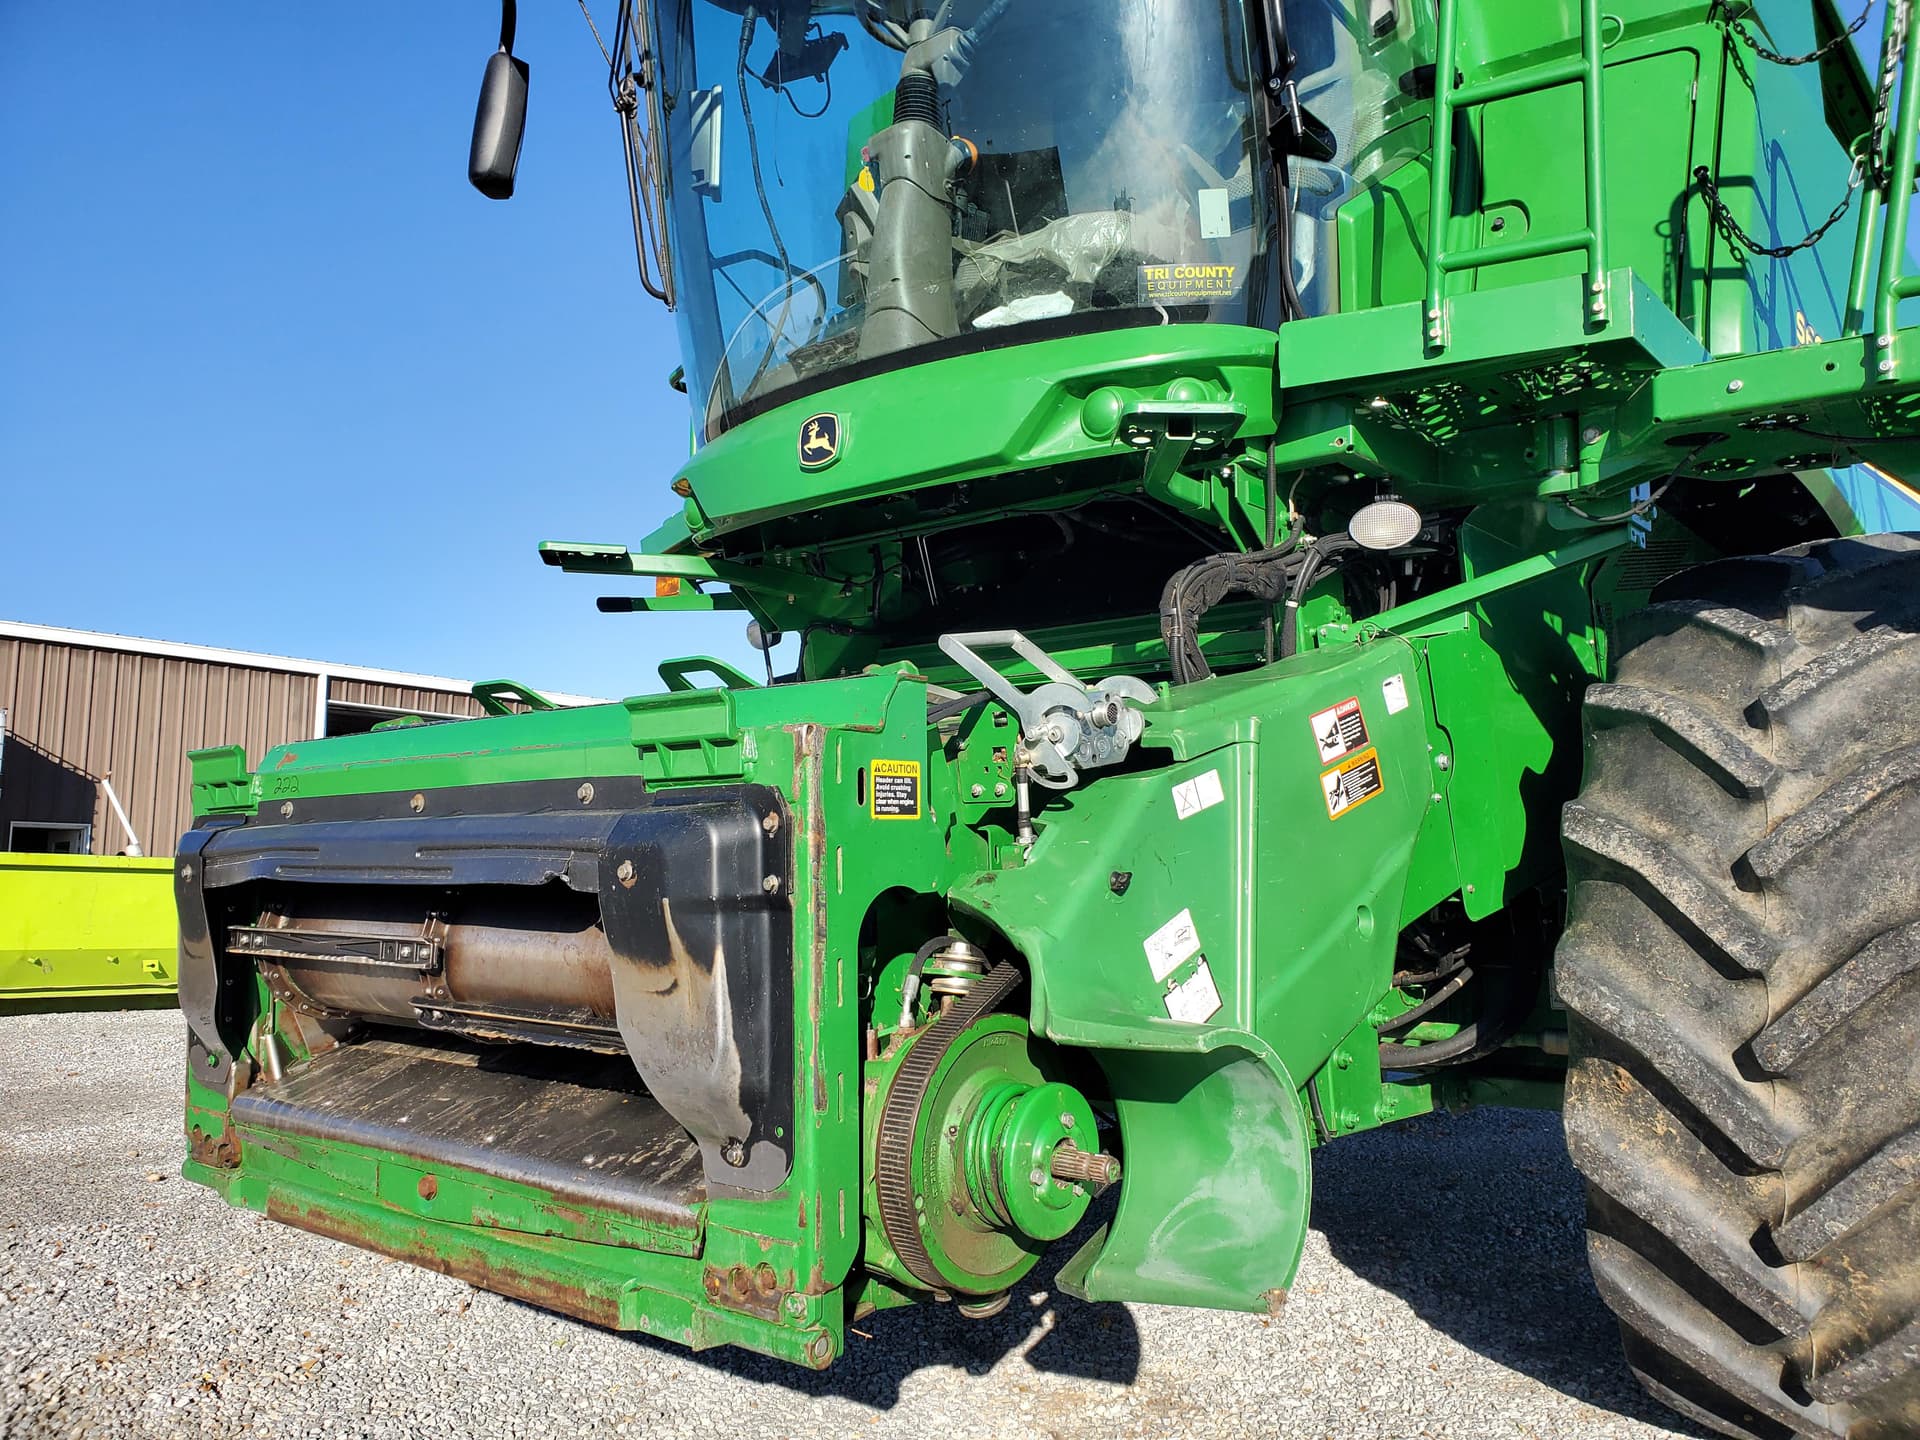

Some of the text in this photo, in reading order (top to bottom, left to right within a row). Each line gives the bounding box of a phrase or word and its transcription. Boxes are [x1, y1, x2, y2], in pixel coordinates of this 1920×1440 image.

[1144, 266, 1235, 280] TRI COUNTY
[1147, 279, 1233, 291] EQUIPMENT
[1796, 311, 1823, 345] S6
[880, 763, 918, 774] CAUTION
